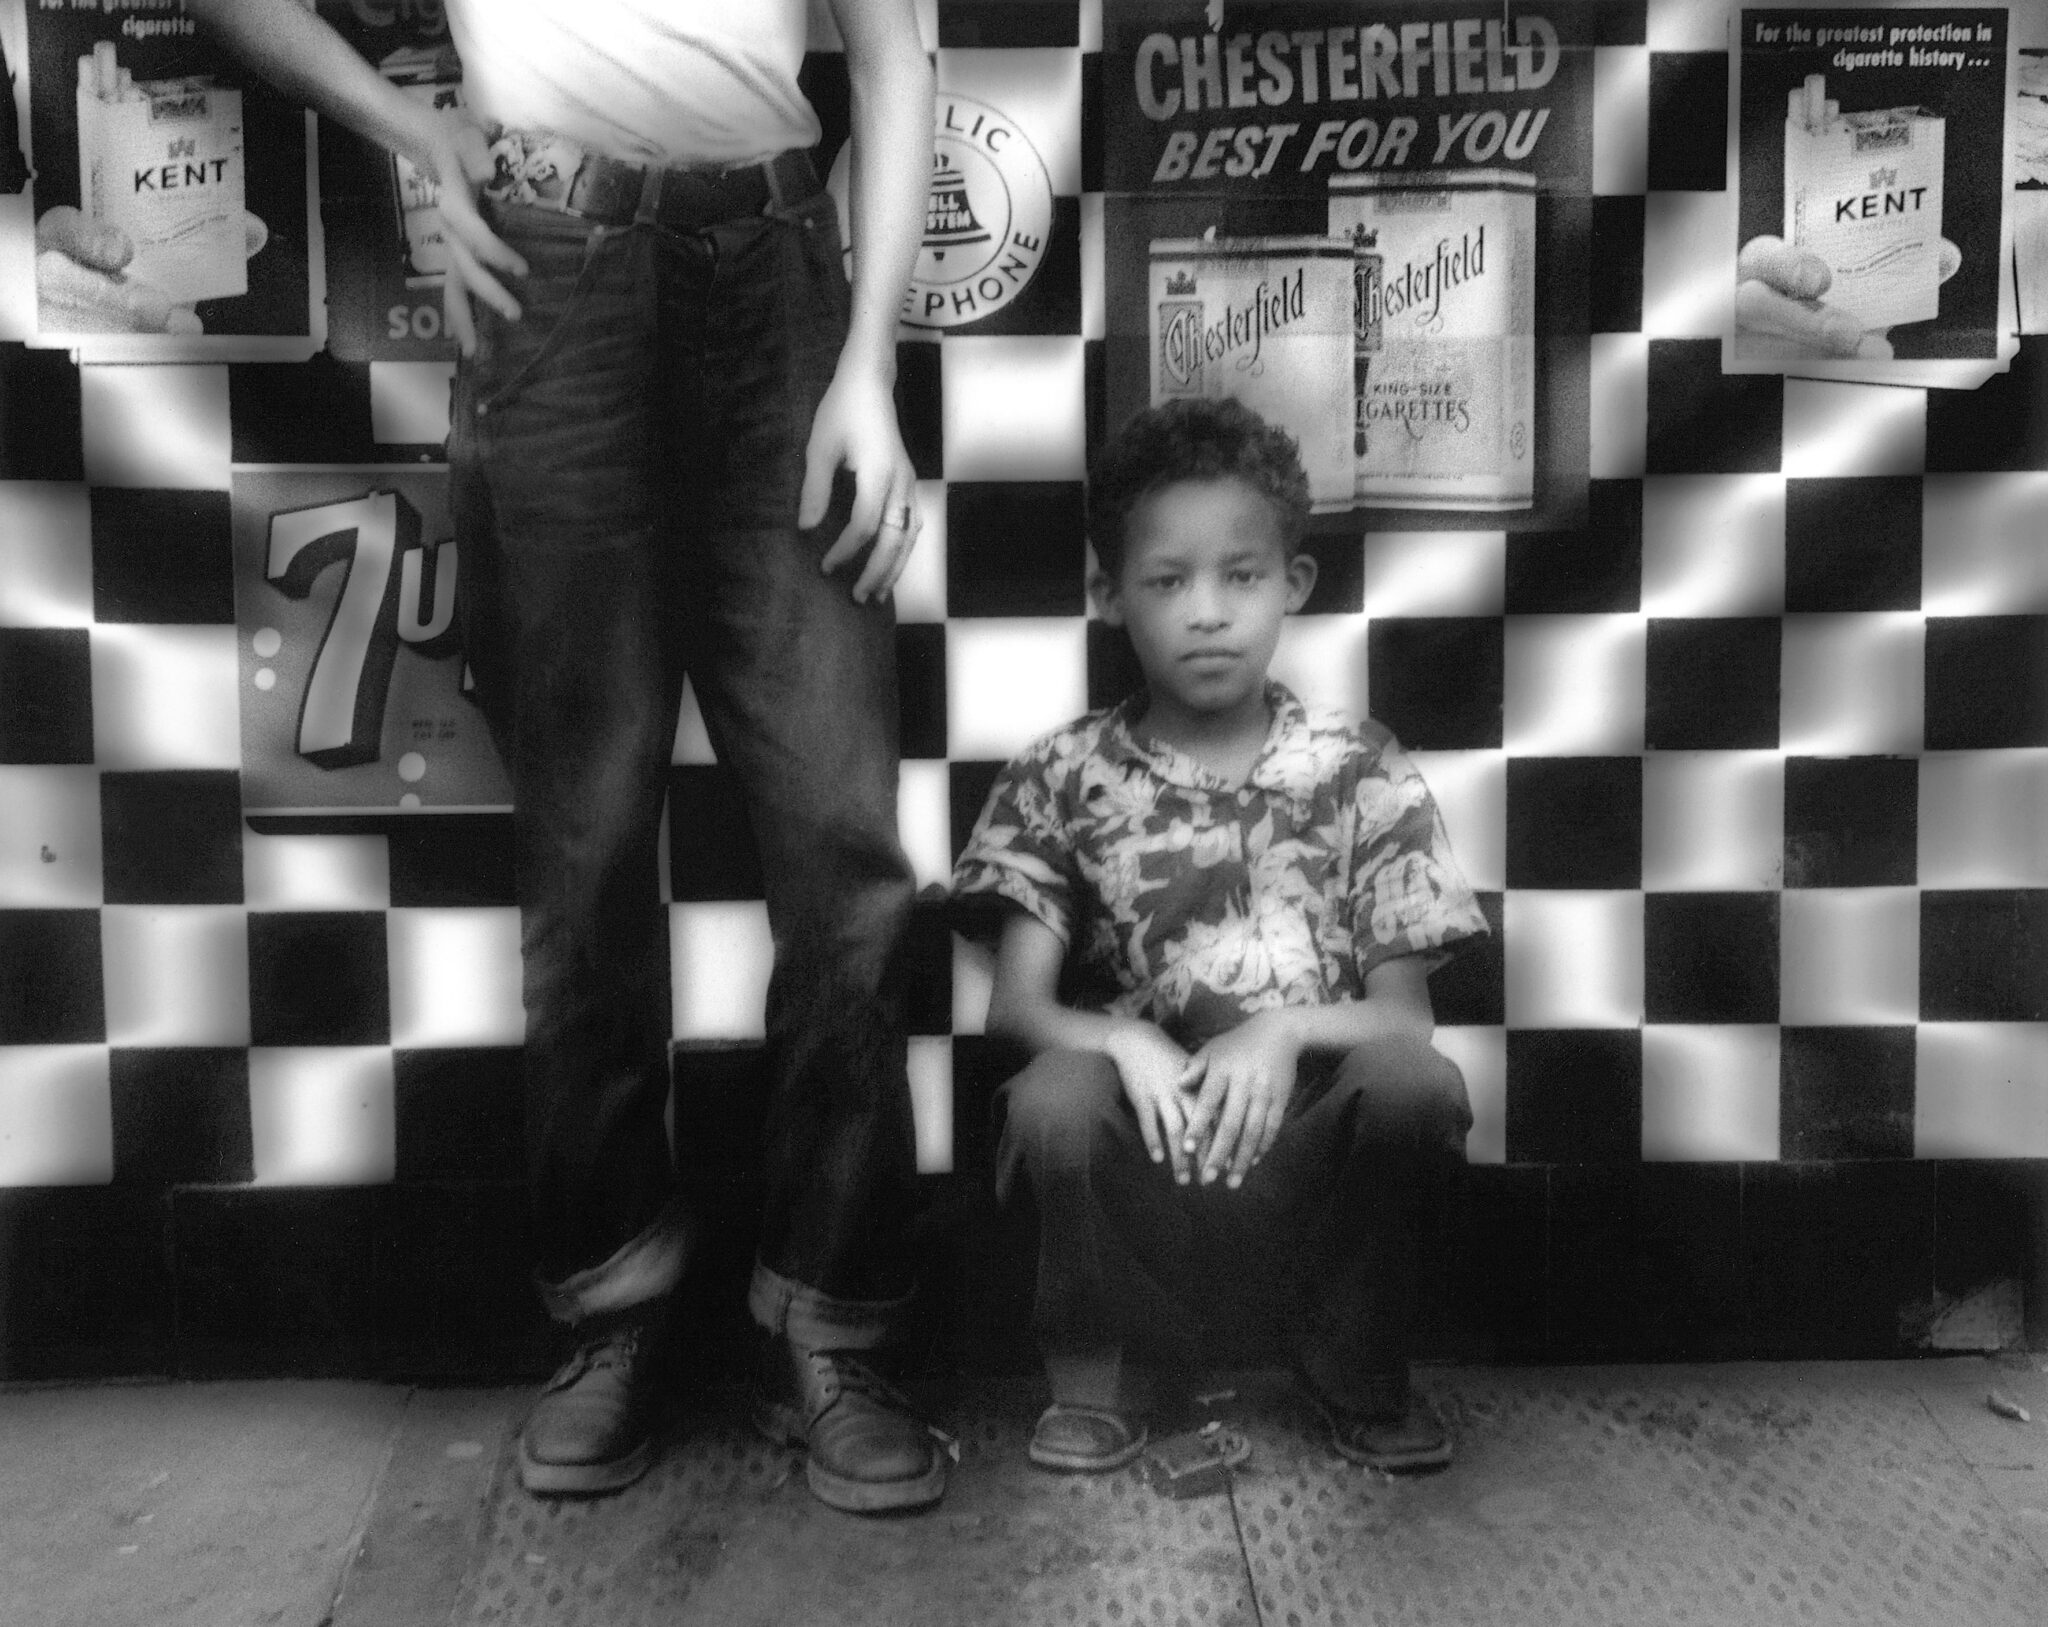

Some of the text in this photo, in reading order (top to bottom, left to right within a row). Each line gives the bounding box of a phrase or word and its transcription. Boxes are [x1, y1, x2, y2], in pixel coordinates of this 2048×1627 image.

[121, 14, 195, 40] cigarette
[1755, 22, 1992, 47] For the greatest protection in
[1135, 16, 1560, 121] CHESTERFIELD
[1832, 47, 1904, 72] cigarette
[944, 104, 1011, 152] LIC
[1152, 108, 1551, 182] BEST FOR YOU
[134, 158, 229, 193] KENT
[929, 193, 960, 211] ELL
[1836, 187, 1928, 222] KENT
[926, 210, 971, 230] STEM
[903, 232, 1040, 317] EPHONE
[1164, 268, 1306, 385] Chesterfield
[1373, 382, 1452, 396] KING-SIZE
[1355, 399, 1470, 442] IGARETTES
